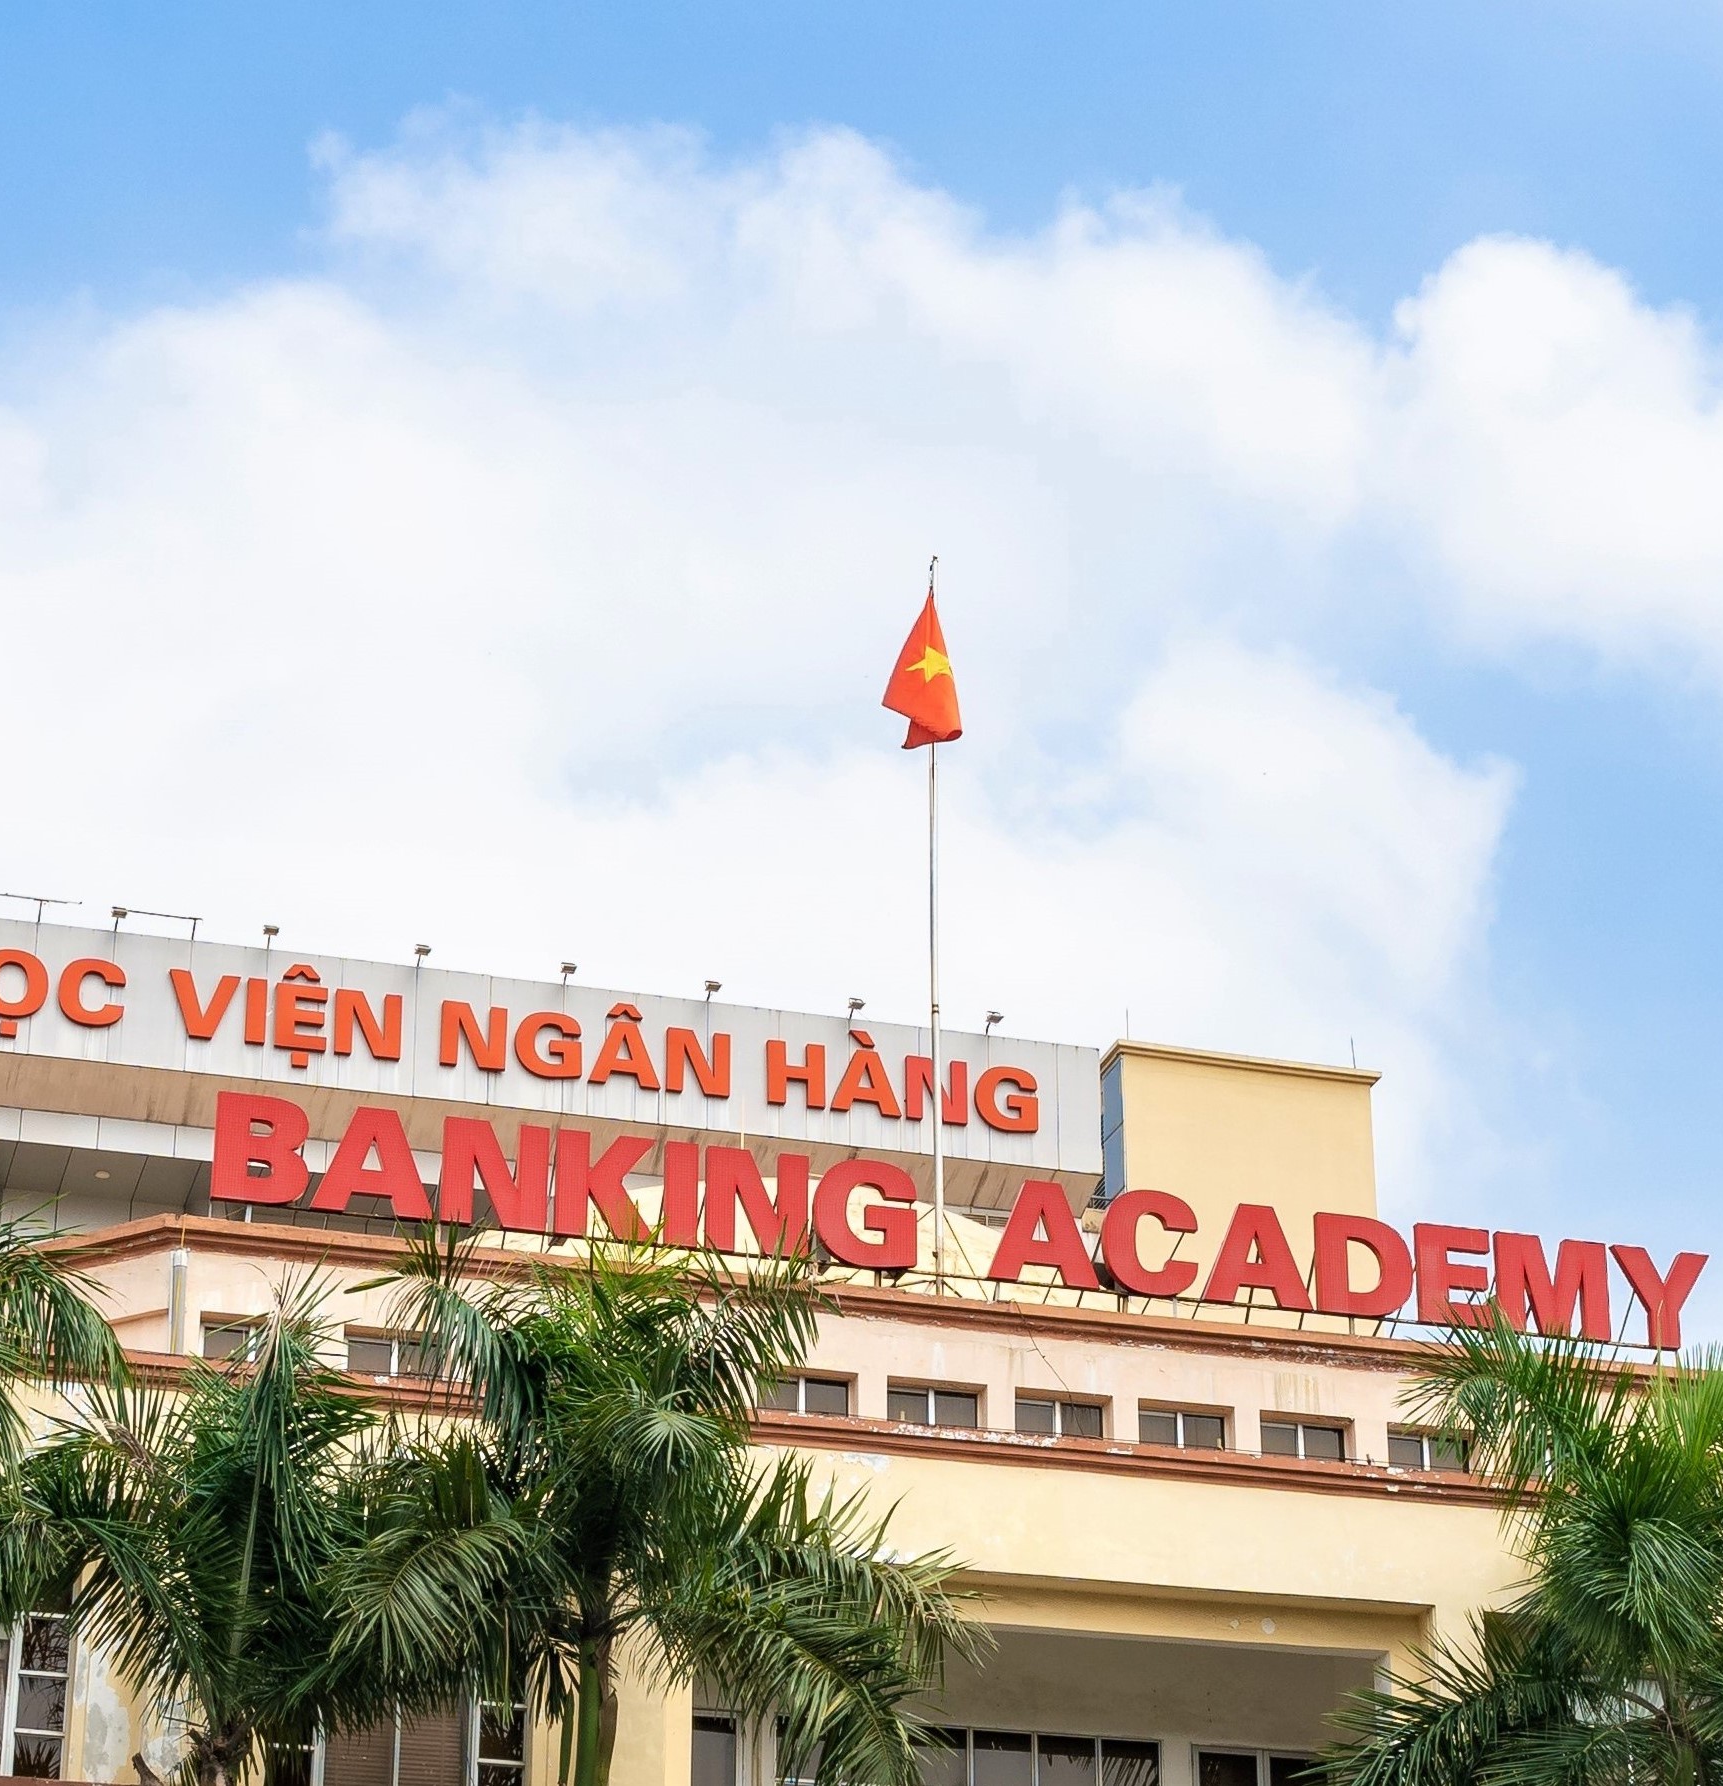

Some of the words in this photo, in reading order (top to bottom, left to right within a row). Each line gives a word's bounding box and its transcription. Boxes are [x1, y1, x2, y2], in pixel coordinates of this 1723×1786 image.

[168, 964, 403, 1067] VIỆN
[439, 1000, 731, 1098] NGÂN
[765, 1030, 1039, 1133] HÀNG
[210, 1090, 918, 1270] BANKING
[987, 1179, 1709, 1350] ACADEMY
